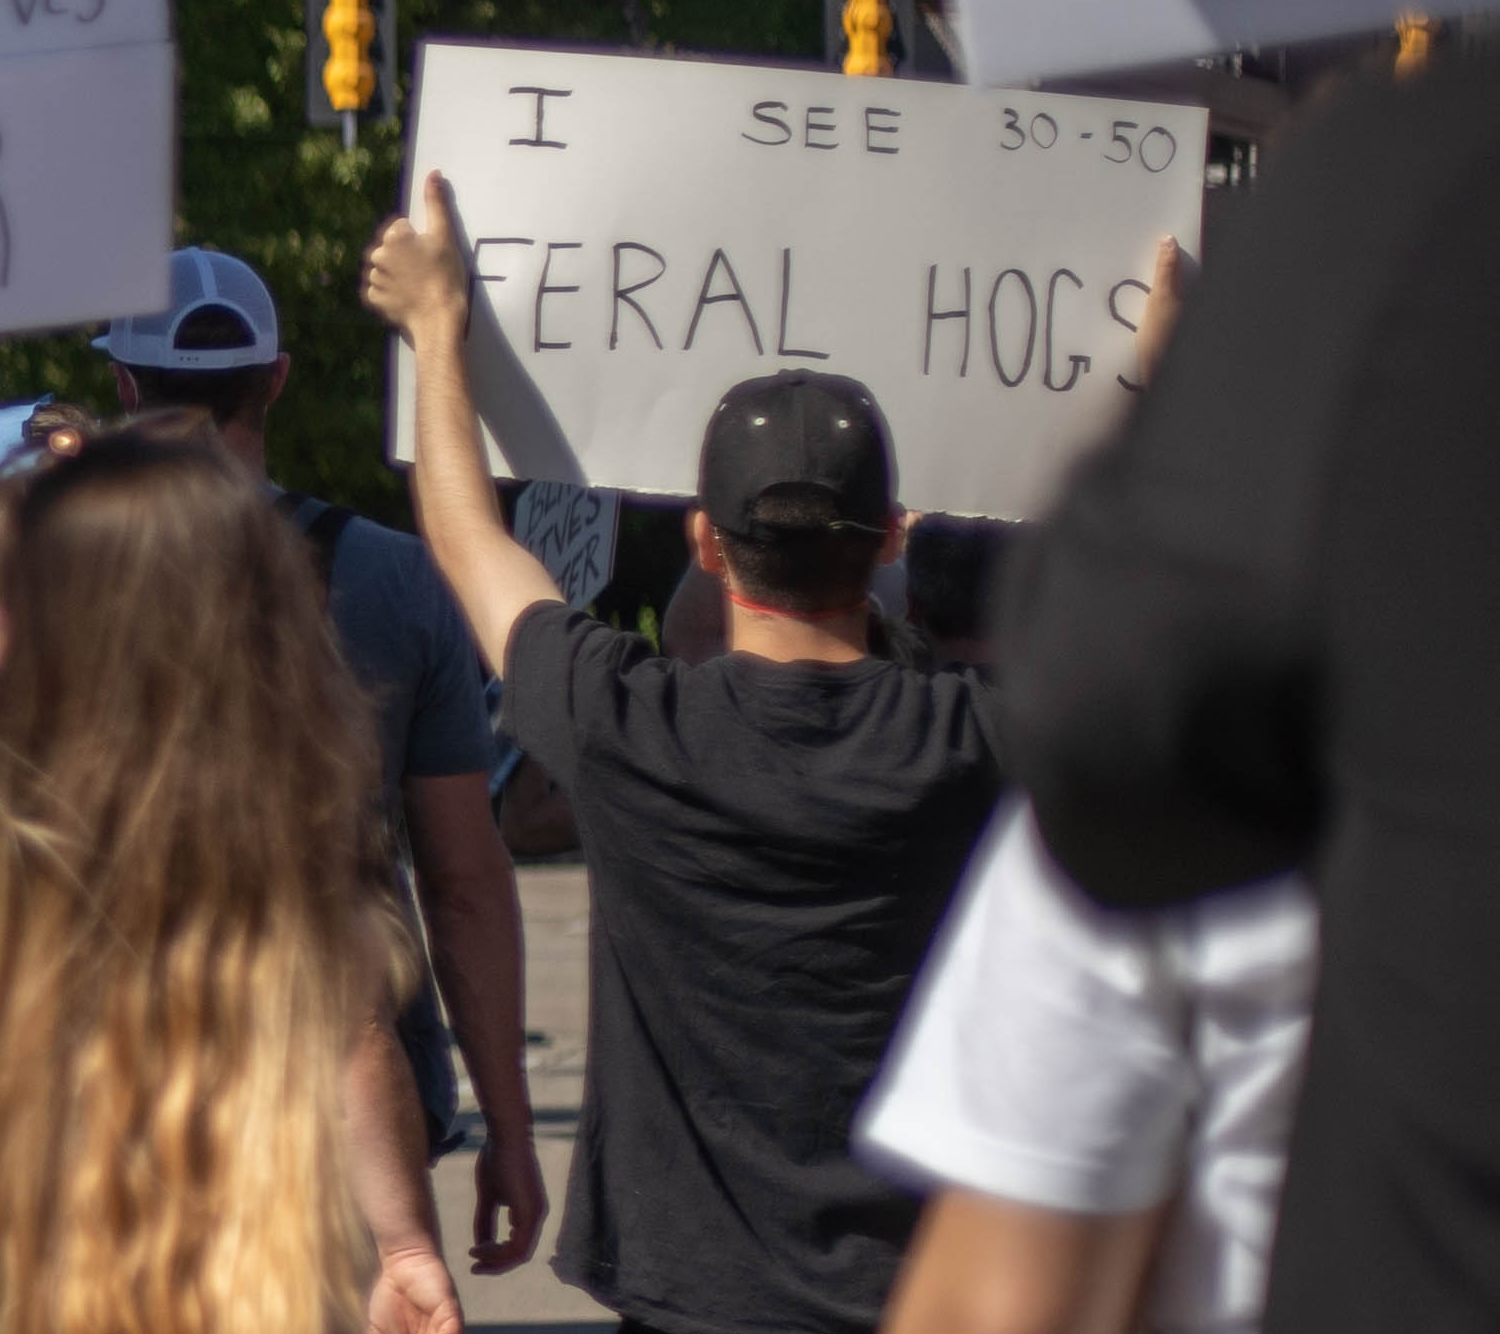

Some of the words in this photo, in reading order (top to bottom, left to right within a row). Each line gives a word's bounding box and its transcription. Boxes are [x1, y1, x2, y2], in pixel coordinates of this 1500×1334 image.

[507, 85, 573, 150] I
[741, 101, 903, 155] SEE
[464, 237, 831, 361] FERAL
[923, 264, 1152, 394] HOGS
[527, 489, 602, 565] IVES
